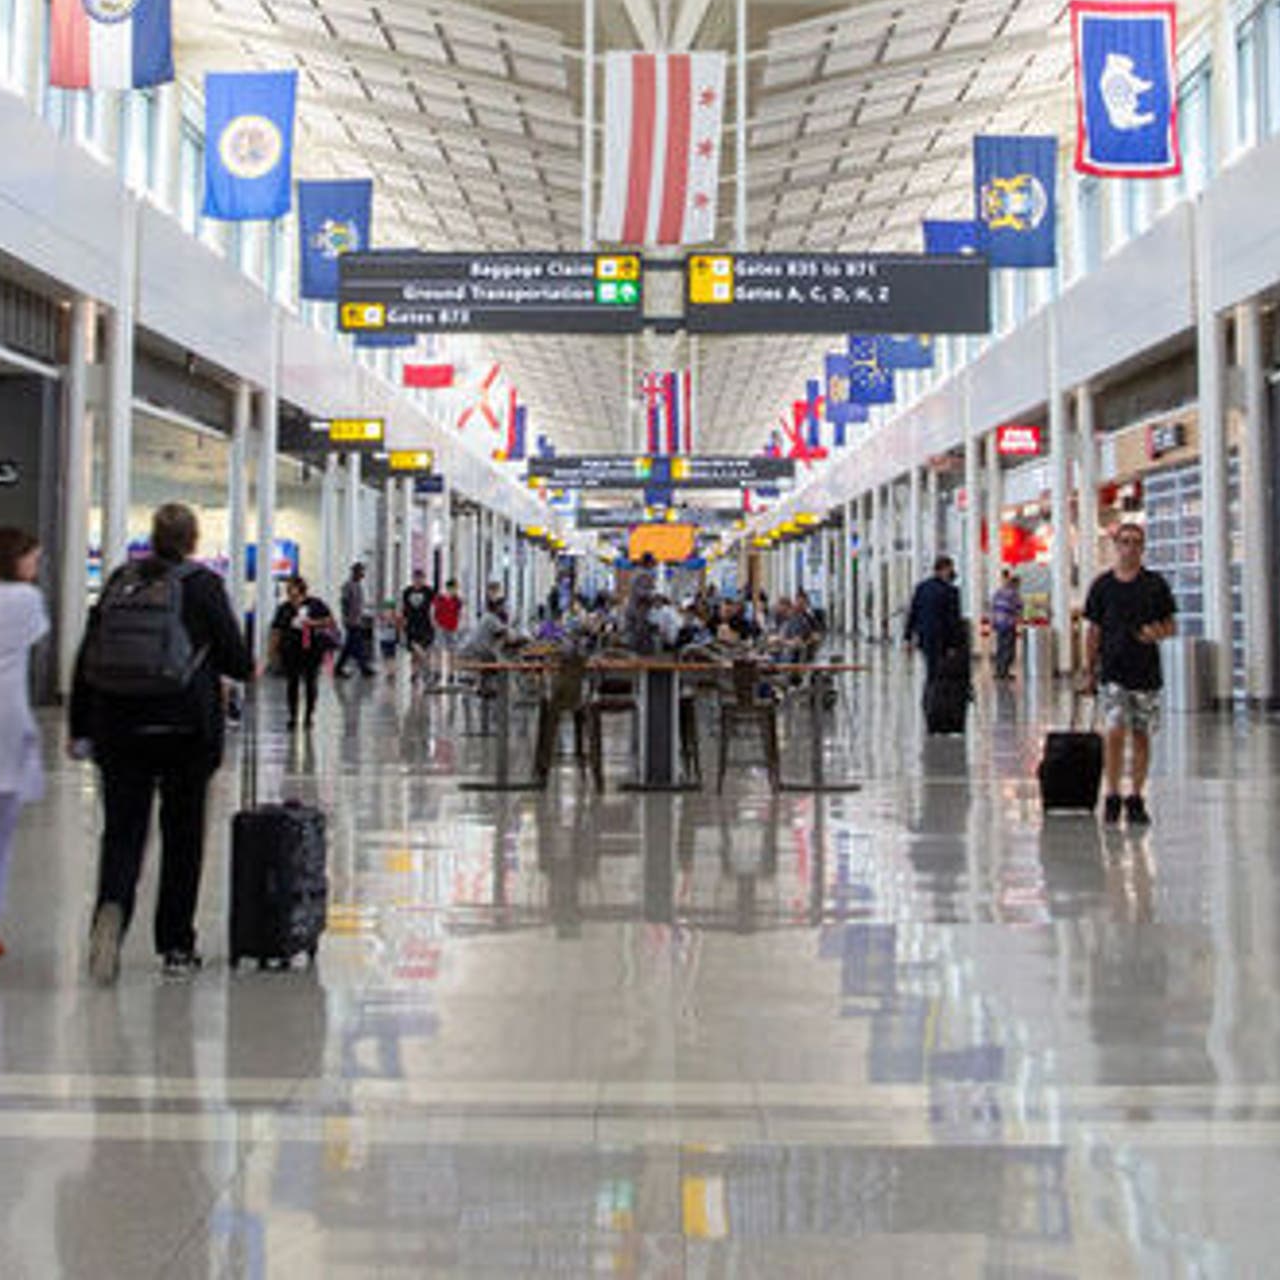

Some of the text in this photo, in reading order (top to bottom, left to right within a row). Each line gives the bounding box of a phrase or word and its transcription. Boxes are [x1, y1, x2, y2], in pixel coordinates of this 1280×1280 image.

[471, 261, 594, 279] Baggage Claim
[736, 260, 782, 276] Gates
[402, 284, 594, 303] Ground Transportation
[735, 285, 782, 300] Gates
